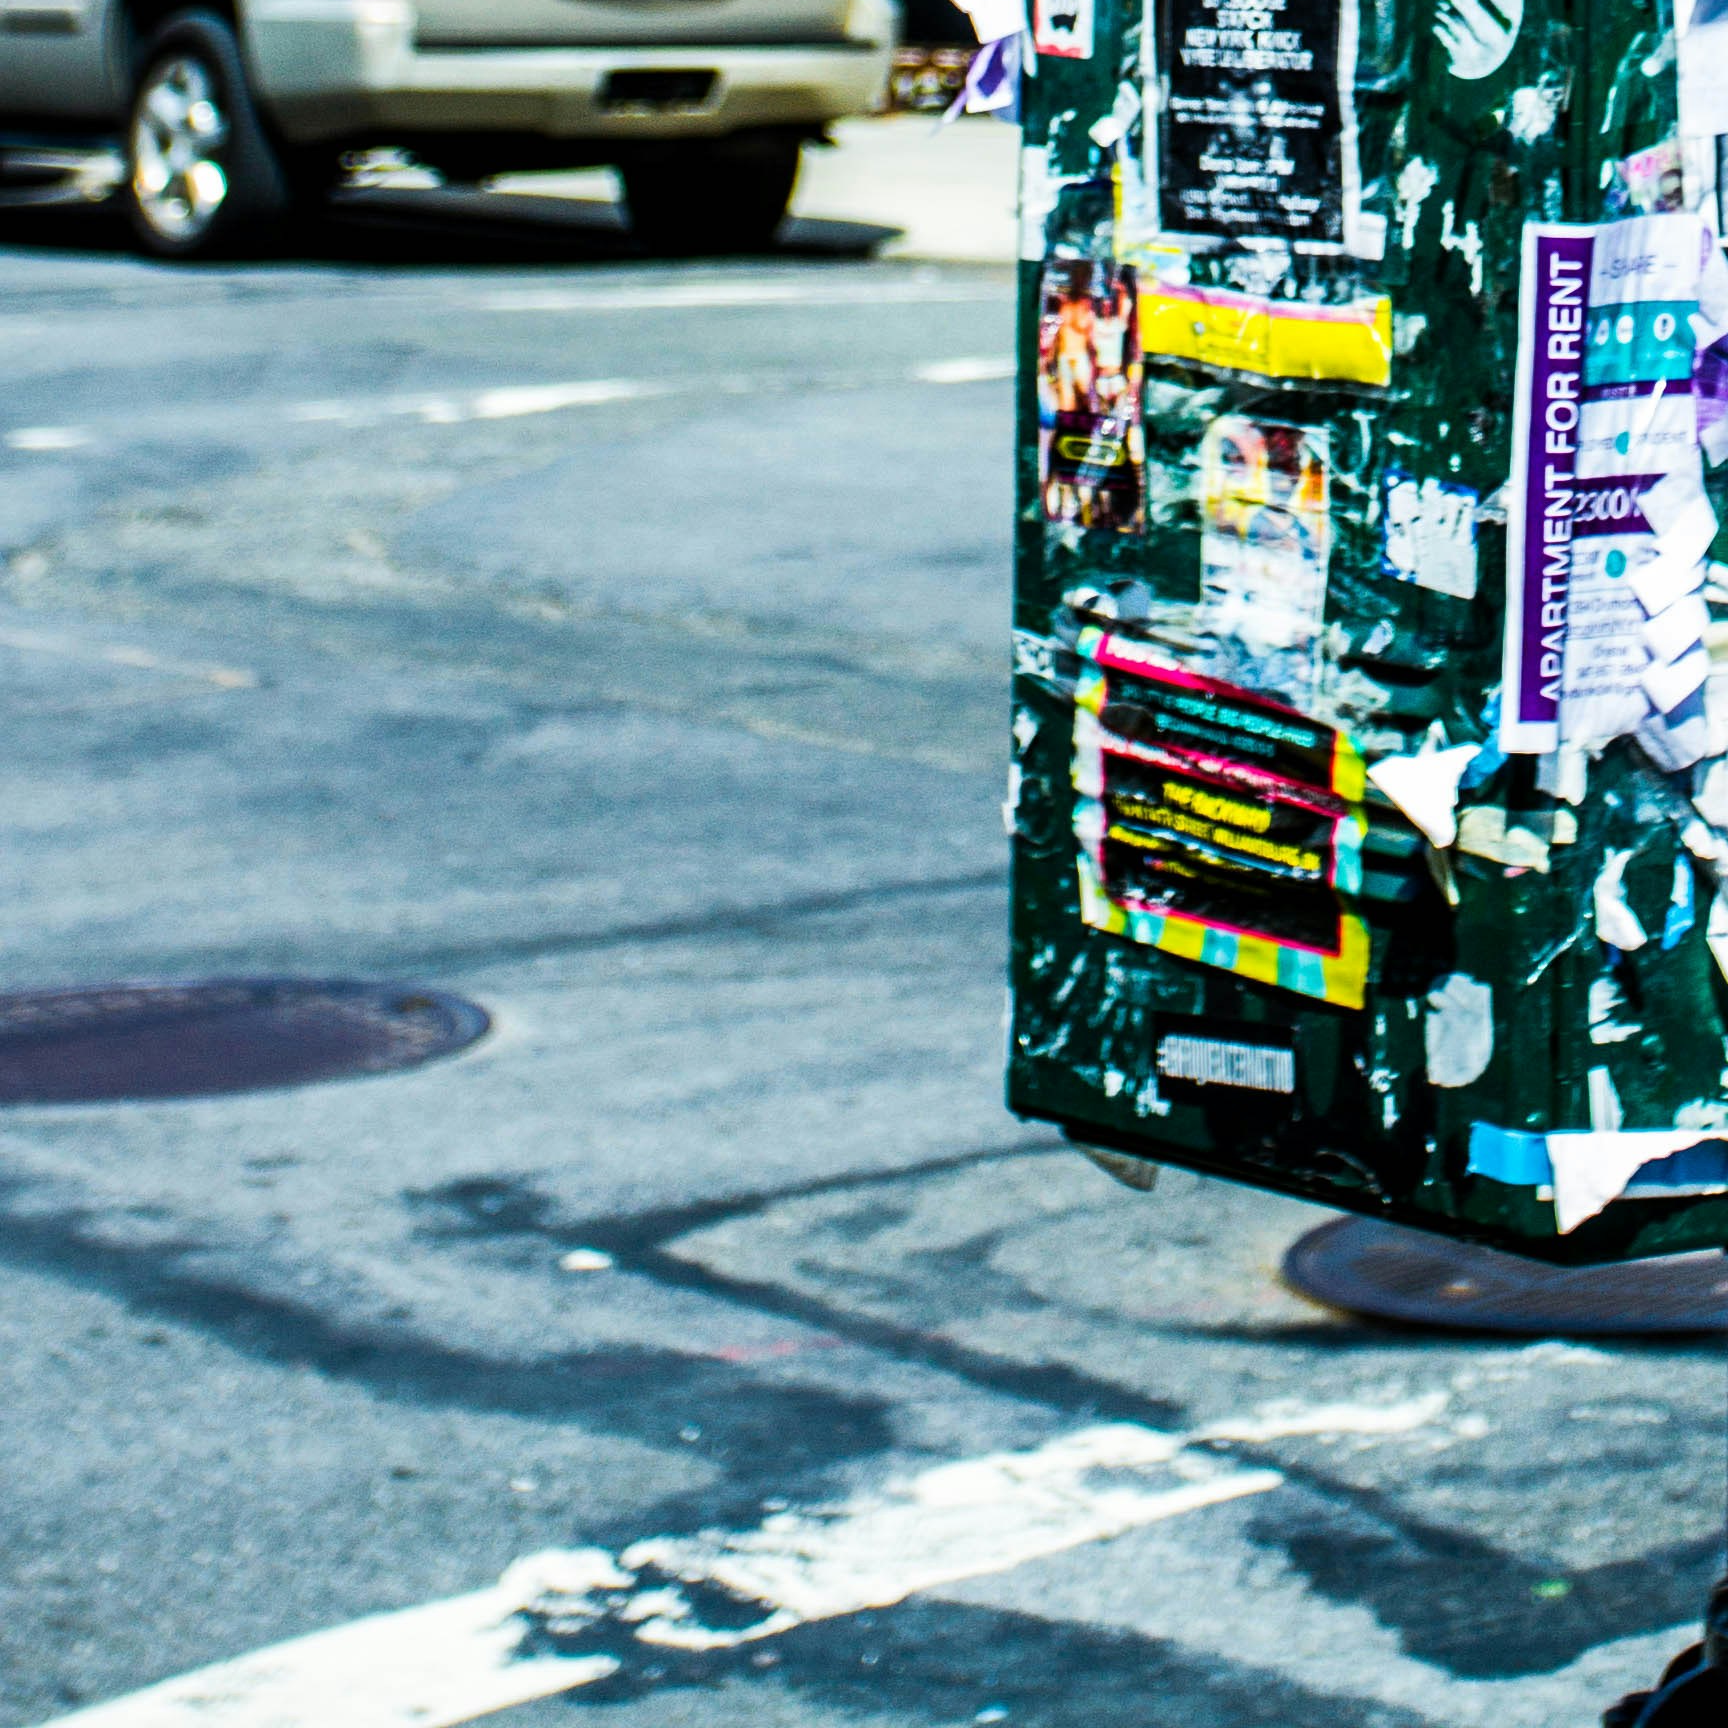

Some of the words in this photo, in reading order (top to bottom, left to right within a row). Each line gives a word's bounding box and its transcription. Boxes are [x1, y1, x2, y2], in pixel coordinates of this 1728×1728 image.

[1547, 251, 1583, 360] RENT
[1545, 371, 1579, 455] FOR
[1539, 464, 1573, 702] APARTMENT
